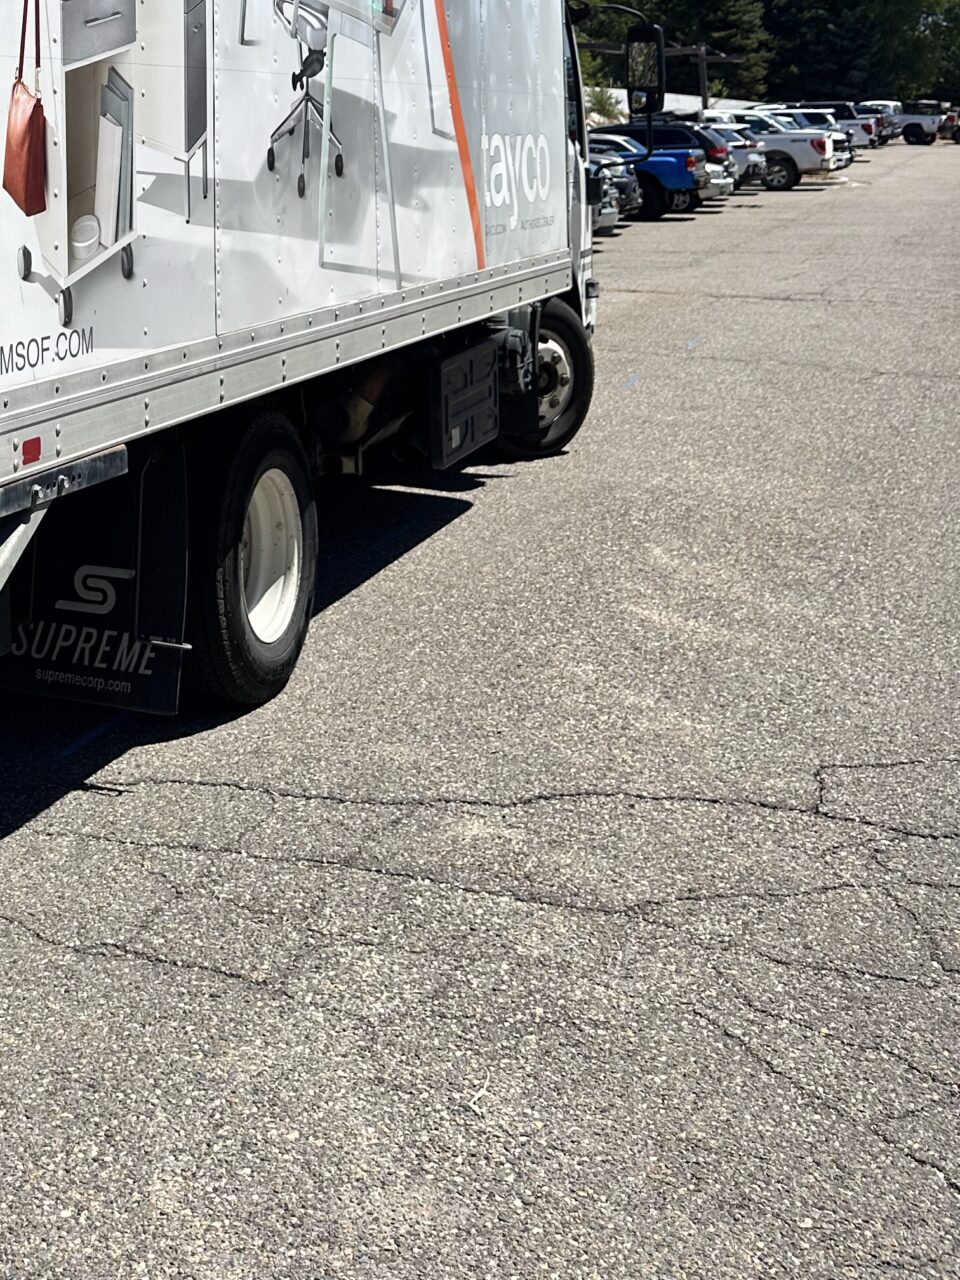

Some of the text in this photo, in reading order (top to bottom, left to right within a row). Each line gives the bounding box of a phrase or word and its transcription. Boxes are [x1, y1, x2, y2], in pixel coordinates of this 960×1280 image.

[0, 326, 95, 376] MSOF.COM
[11, 620, 163, 675] SUPREME
[35, 668, 132, 694] supremecorp.com
